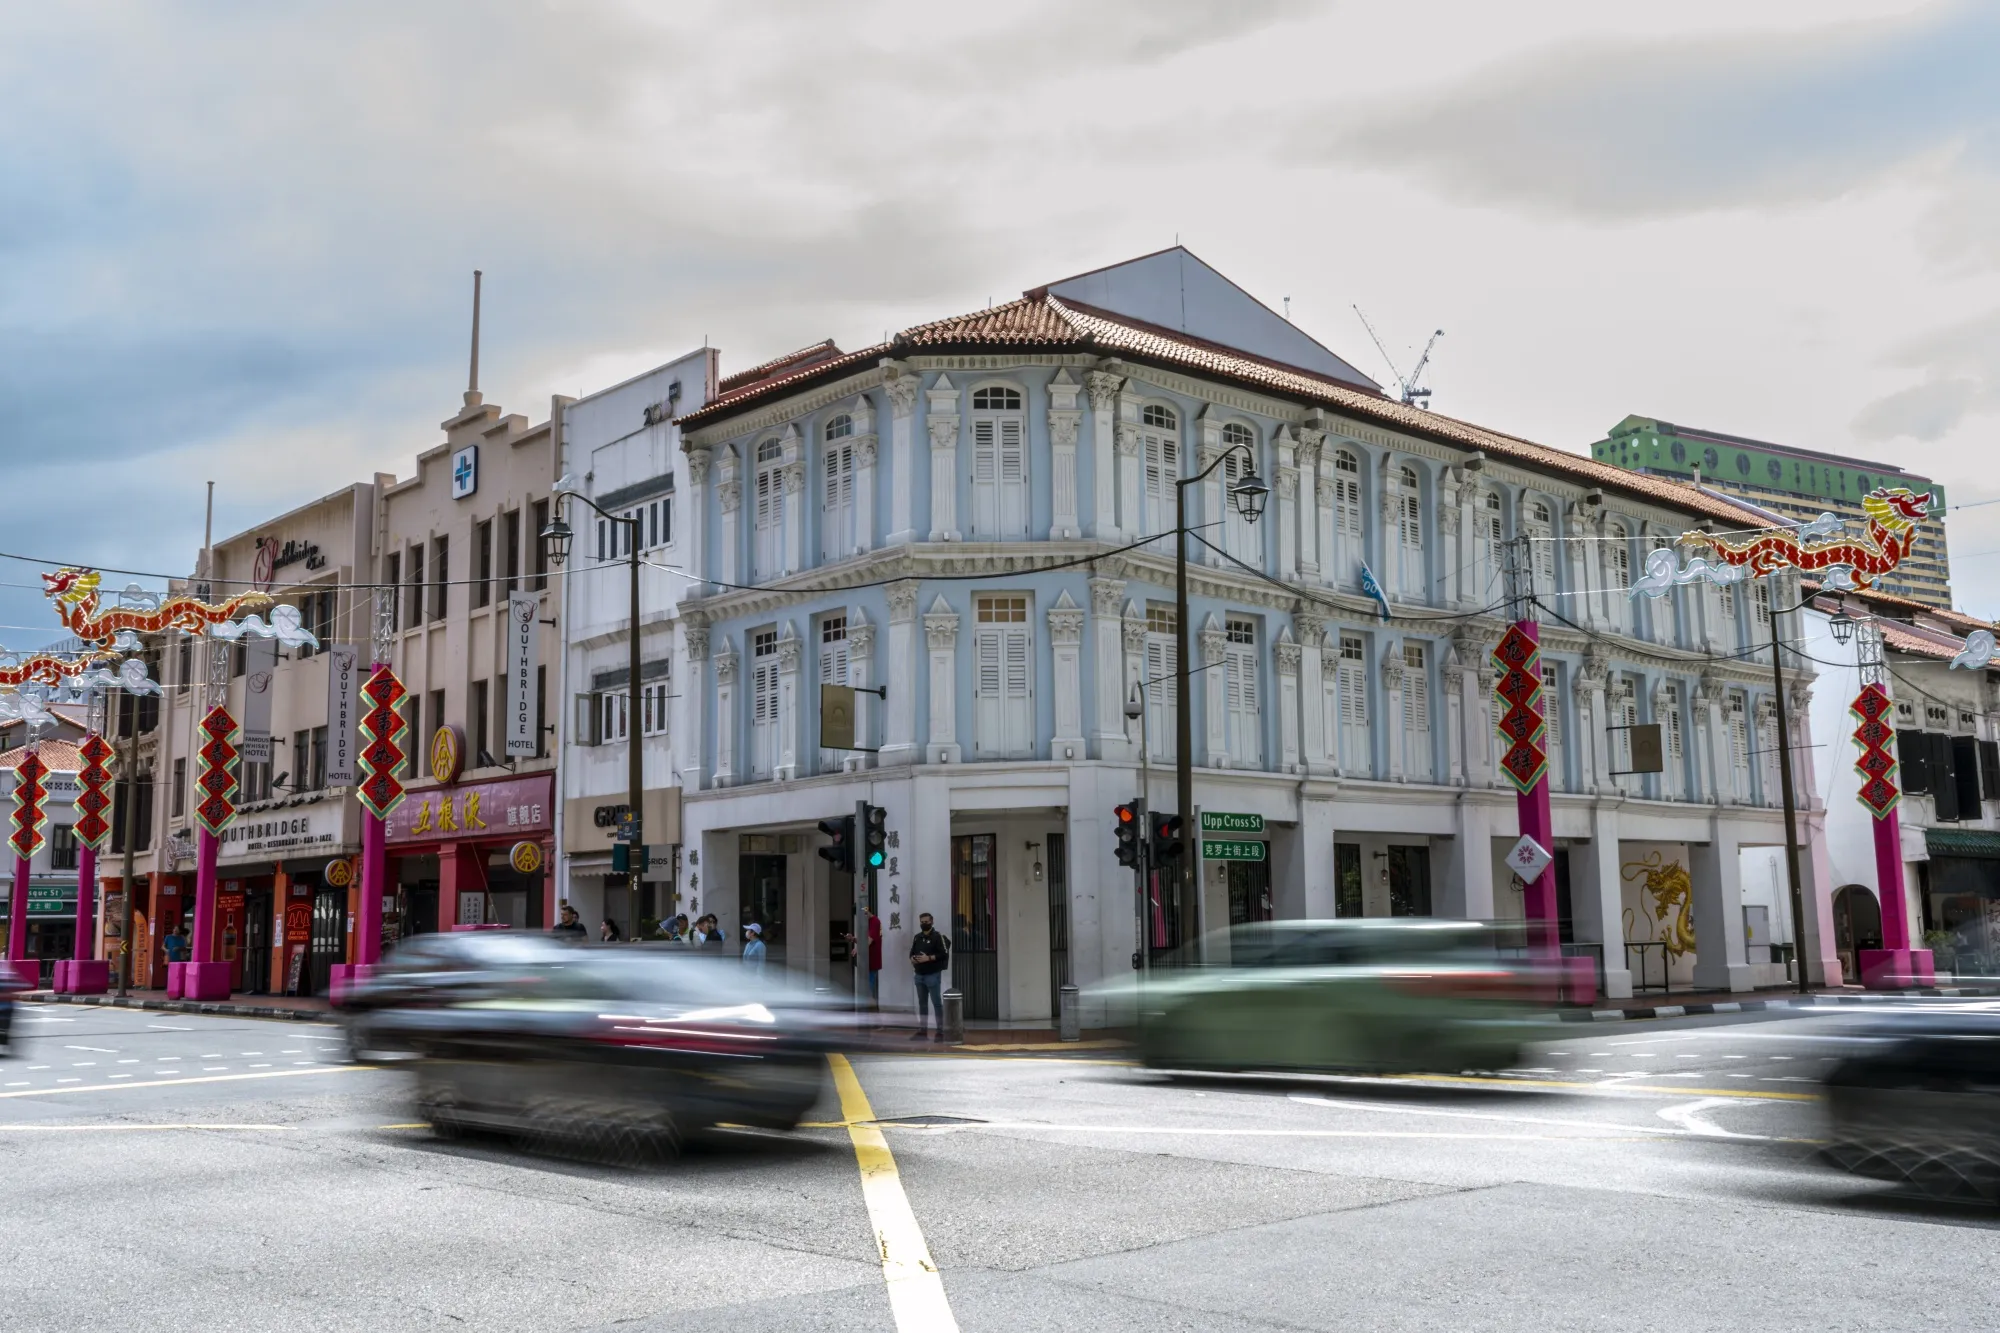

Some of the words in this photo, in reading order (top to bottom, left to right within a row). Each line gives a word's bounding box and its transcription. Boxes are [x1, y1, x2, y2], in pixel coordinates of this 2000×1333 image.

[518, 612, 530, 735] SOUTHBRIDGE
[338, 663, 348, 768] SOUTHBRIDGE
[1503, 634, 1534, 772] 龙年吉祥
[205, 714, 230, 820] 迎春接福
[372, 678, 395, 803] 万事如意
[508, 740, 535, 749] HOTEL
[1862, 692, 1889, 805] 吉祥如意
[84, 741, 106, 835] 五福临门
[328, 772, 352, 780] HOTEL
[221, 817, 308, 844] OUTHBRIDGE
[411, 790, 487, 836] 五粮液
[507, 803, 541, 827] 旗舰店
[1203, 814, 1223, 829] Upp
[1224, 814, 1249, 828] Cross
[1250, 815, 1261, 828] St
[247, 842, 262, 850] HOTEL
[303, 836, 314, 845] BAR
[319, 833, 332, 842] JAZZ
[1205, 843, 1260, 857] 克罗士街上段
[29, 889, 48, 899] sque
[50, 889, 59, 897] St
[887, 830, 902, 931] 福星高照
[136, 923, 145, 984] AUCHENOSHAN
